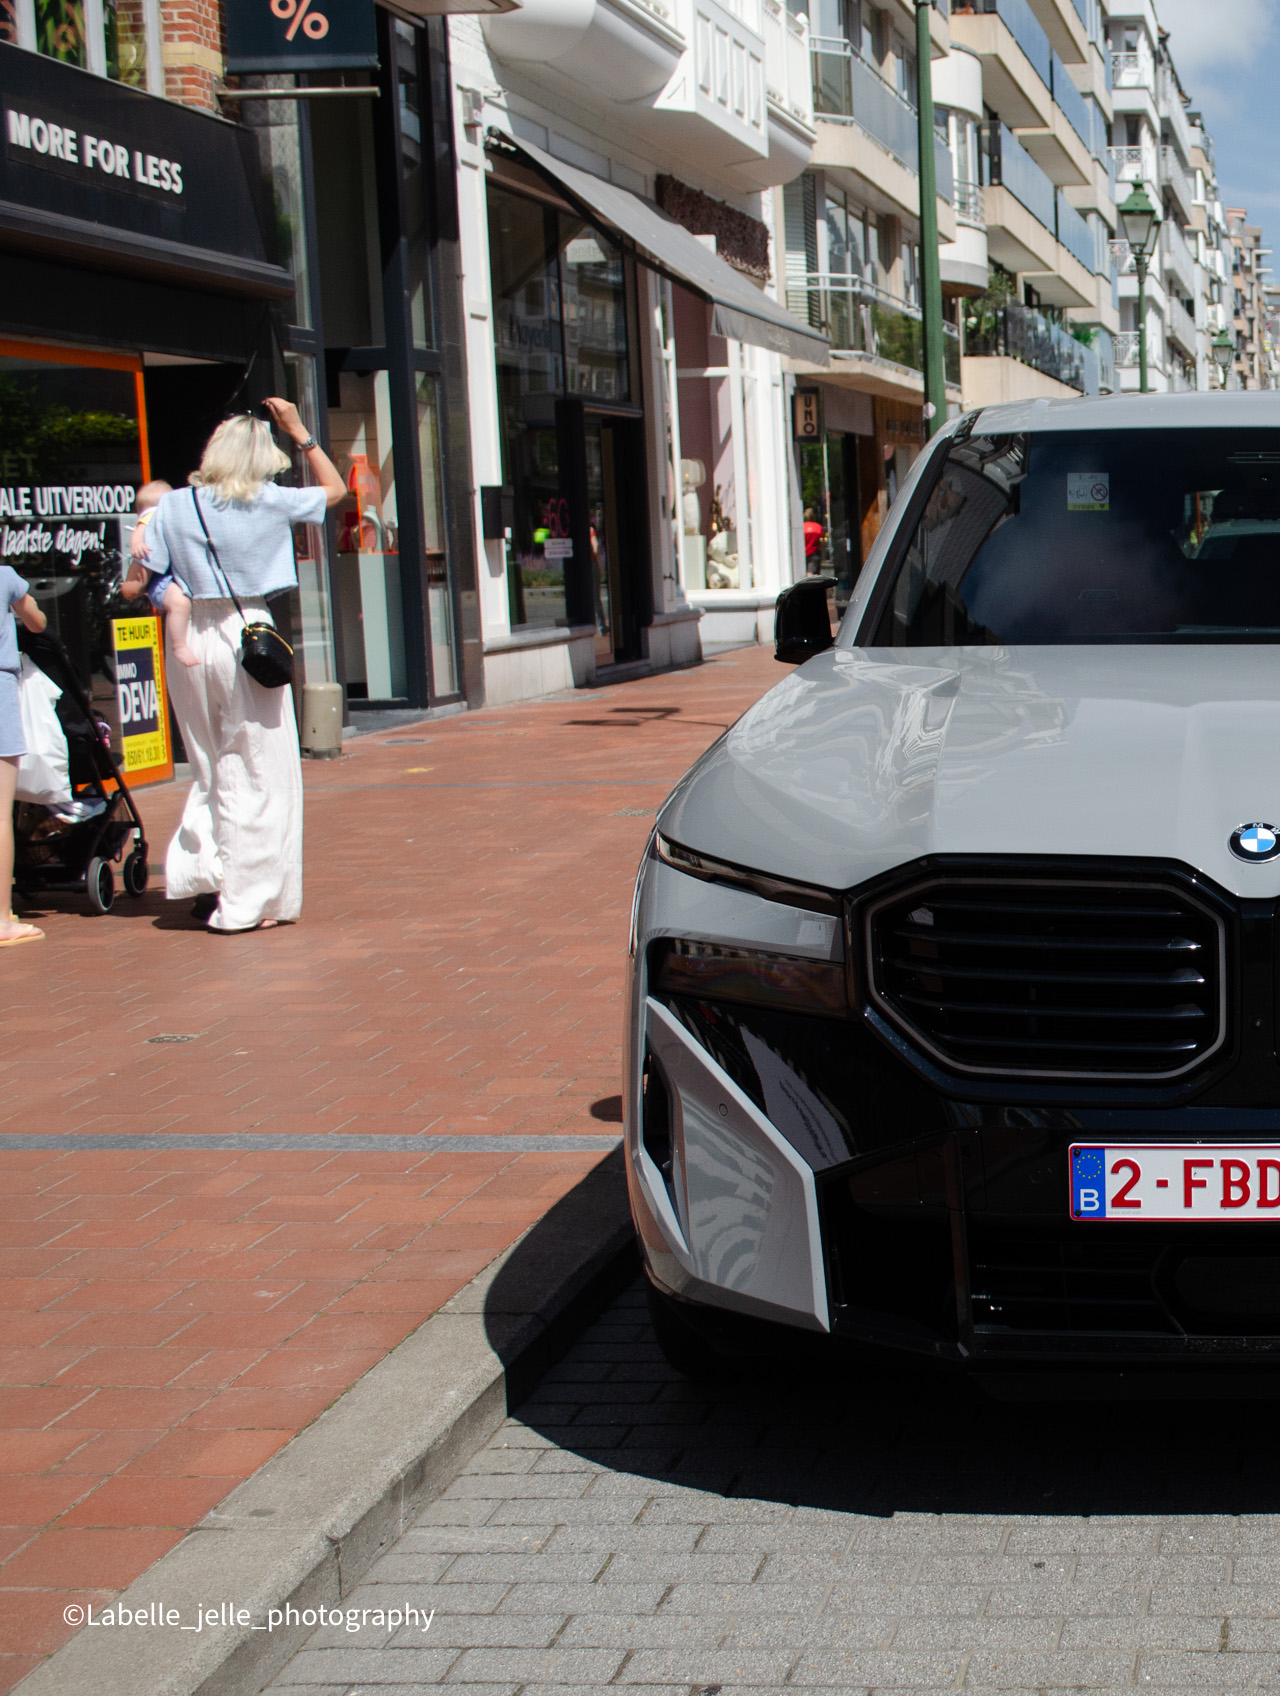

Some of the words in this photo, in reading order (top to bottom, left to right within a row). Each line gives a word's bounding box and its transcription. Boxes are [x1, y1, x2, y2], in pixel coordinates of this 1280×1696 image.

[7, 109, 78, 164] MORE
[84, 134, 130, 179] FOR
[135, 151, 183, 195] LESS
[803, 395, 815, 434] UNO
[34, 485, 136, 516] UITVERKOOP
[2, 522, 53, 557] laatste
[56, 521, 106, 566] dagen!
[117, 627, 127, 641] TE
[128, 624, 152, 641] HUUR
[116, 662, 138, 680] IMMO
[118, 679, 159, 724] DEVA
[1079, 1188, 1100, 1212] B
